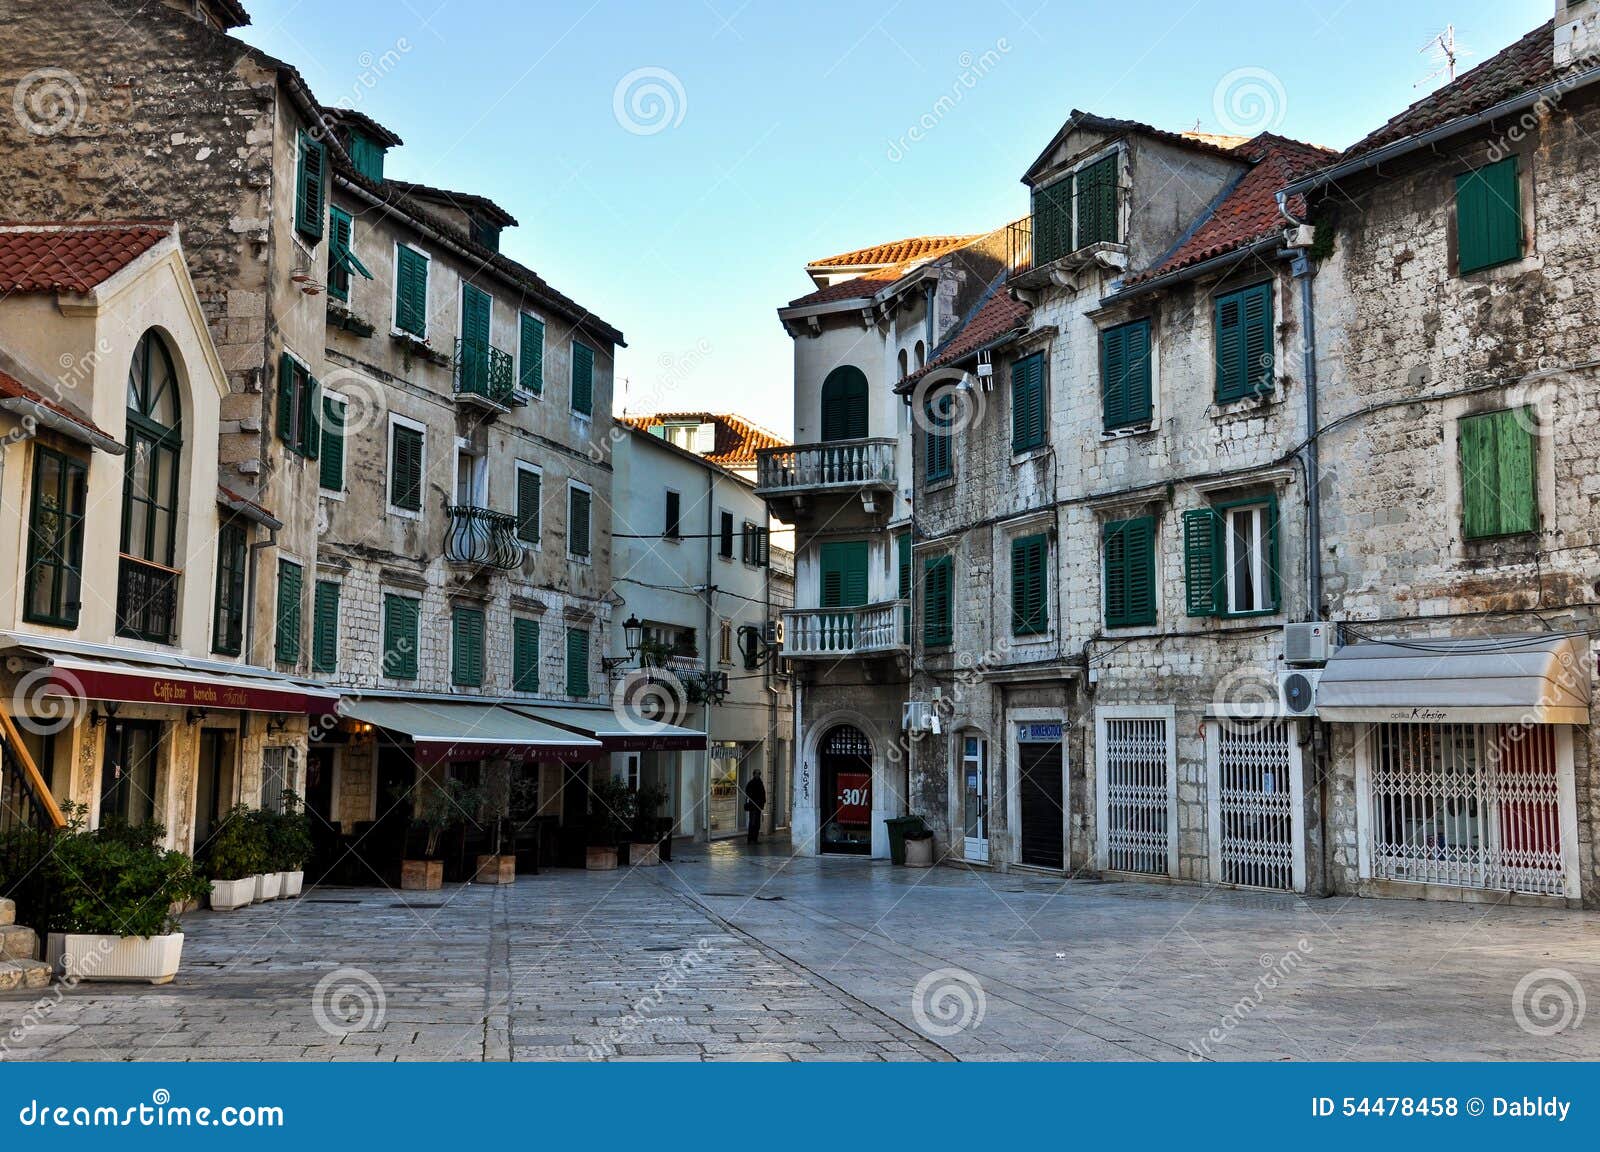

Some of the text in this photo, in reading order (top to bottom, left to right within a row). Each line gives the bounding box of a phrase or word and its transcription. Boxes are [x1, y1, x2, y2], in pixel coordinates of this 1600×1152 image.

[153, 681, 173, 701] Caffe
[174, 683, 187, 699] bar
[193, 685, 217, 702] konoba
[1421, 709, 1448, 722] design
[838, 788, 868, 806] -30%
